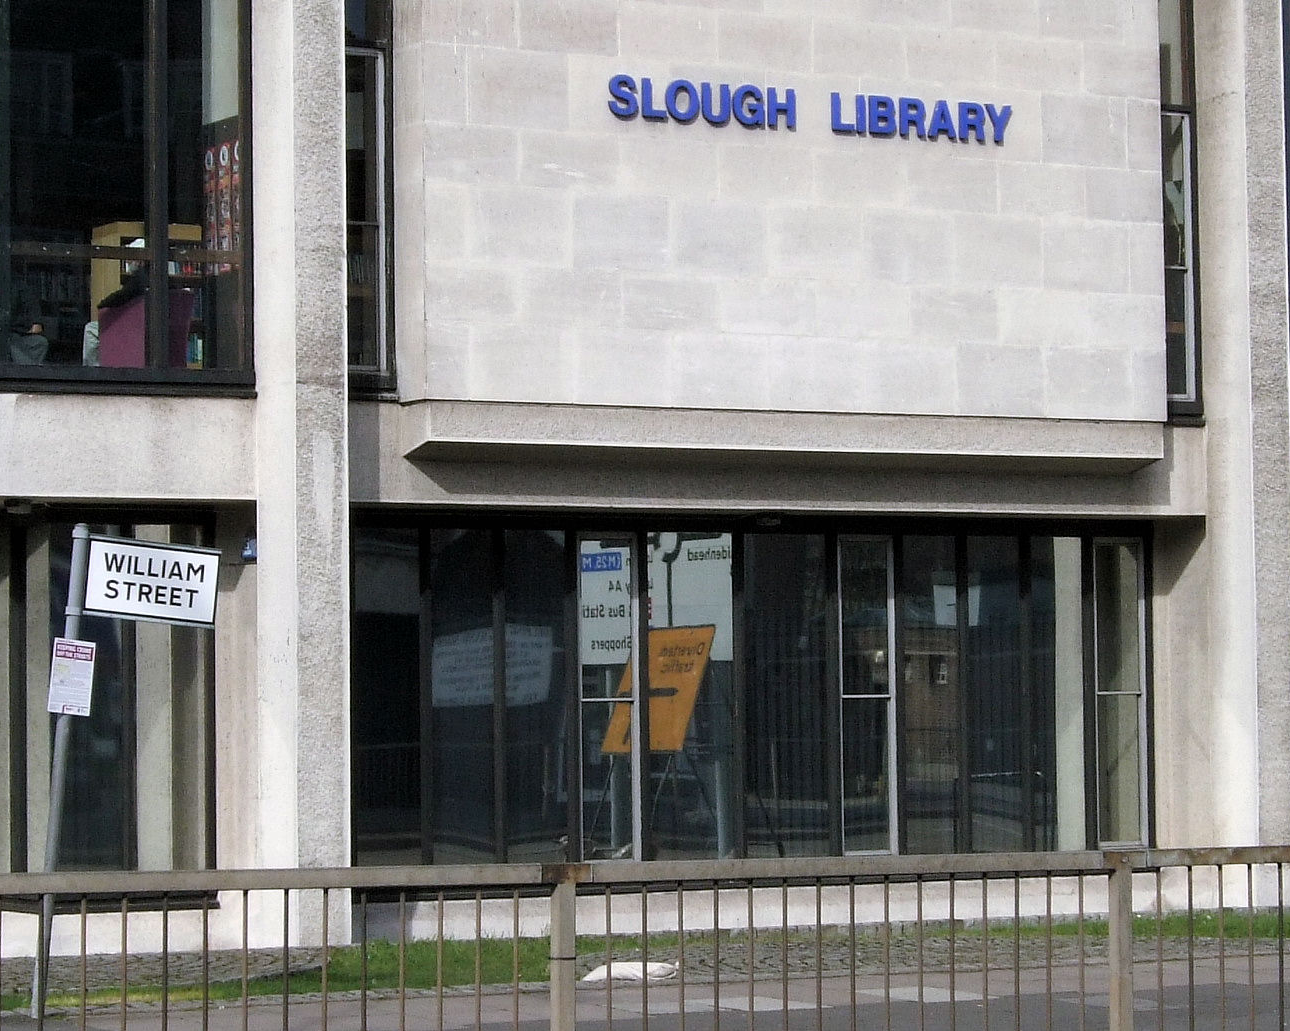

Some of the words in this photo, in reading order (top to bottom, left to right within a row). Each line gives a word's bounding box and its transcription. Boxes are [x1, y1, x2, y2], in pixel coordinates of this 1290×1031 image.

[608, 74, 797, 132] SLOUGH
[830, 92, 1013, 146] LIBRARY
[104, 552, 205, 583] WILLIAM
[104, 579, 199, 608] STREET
